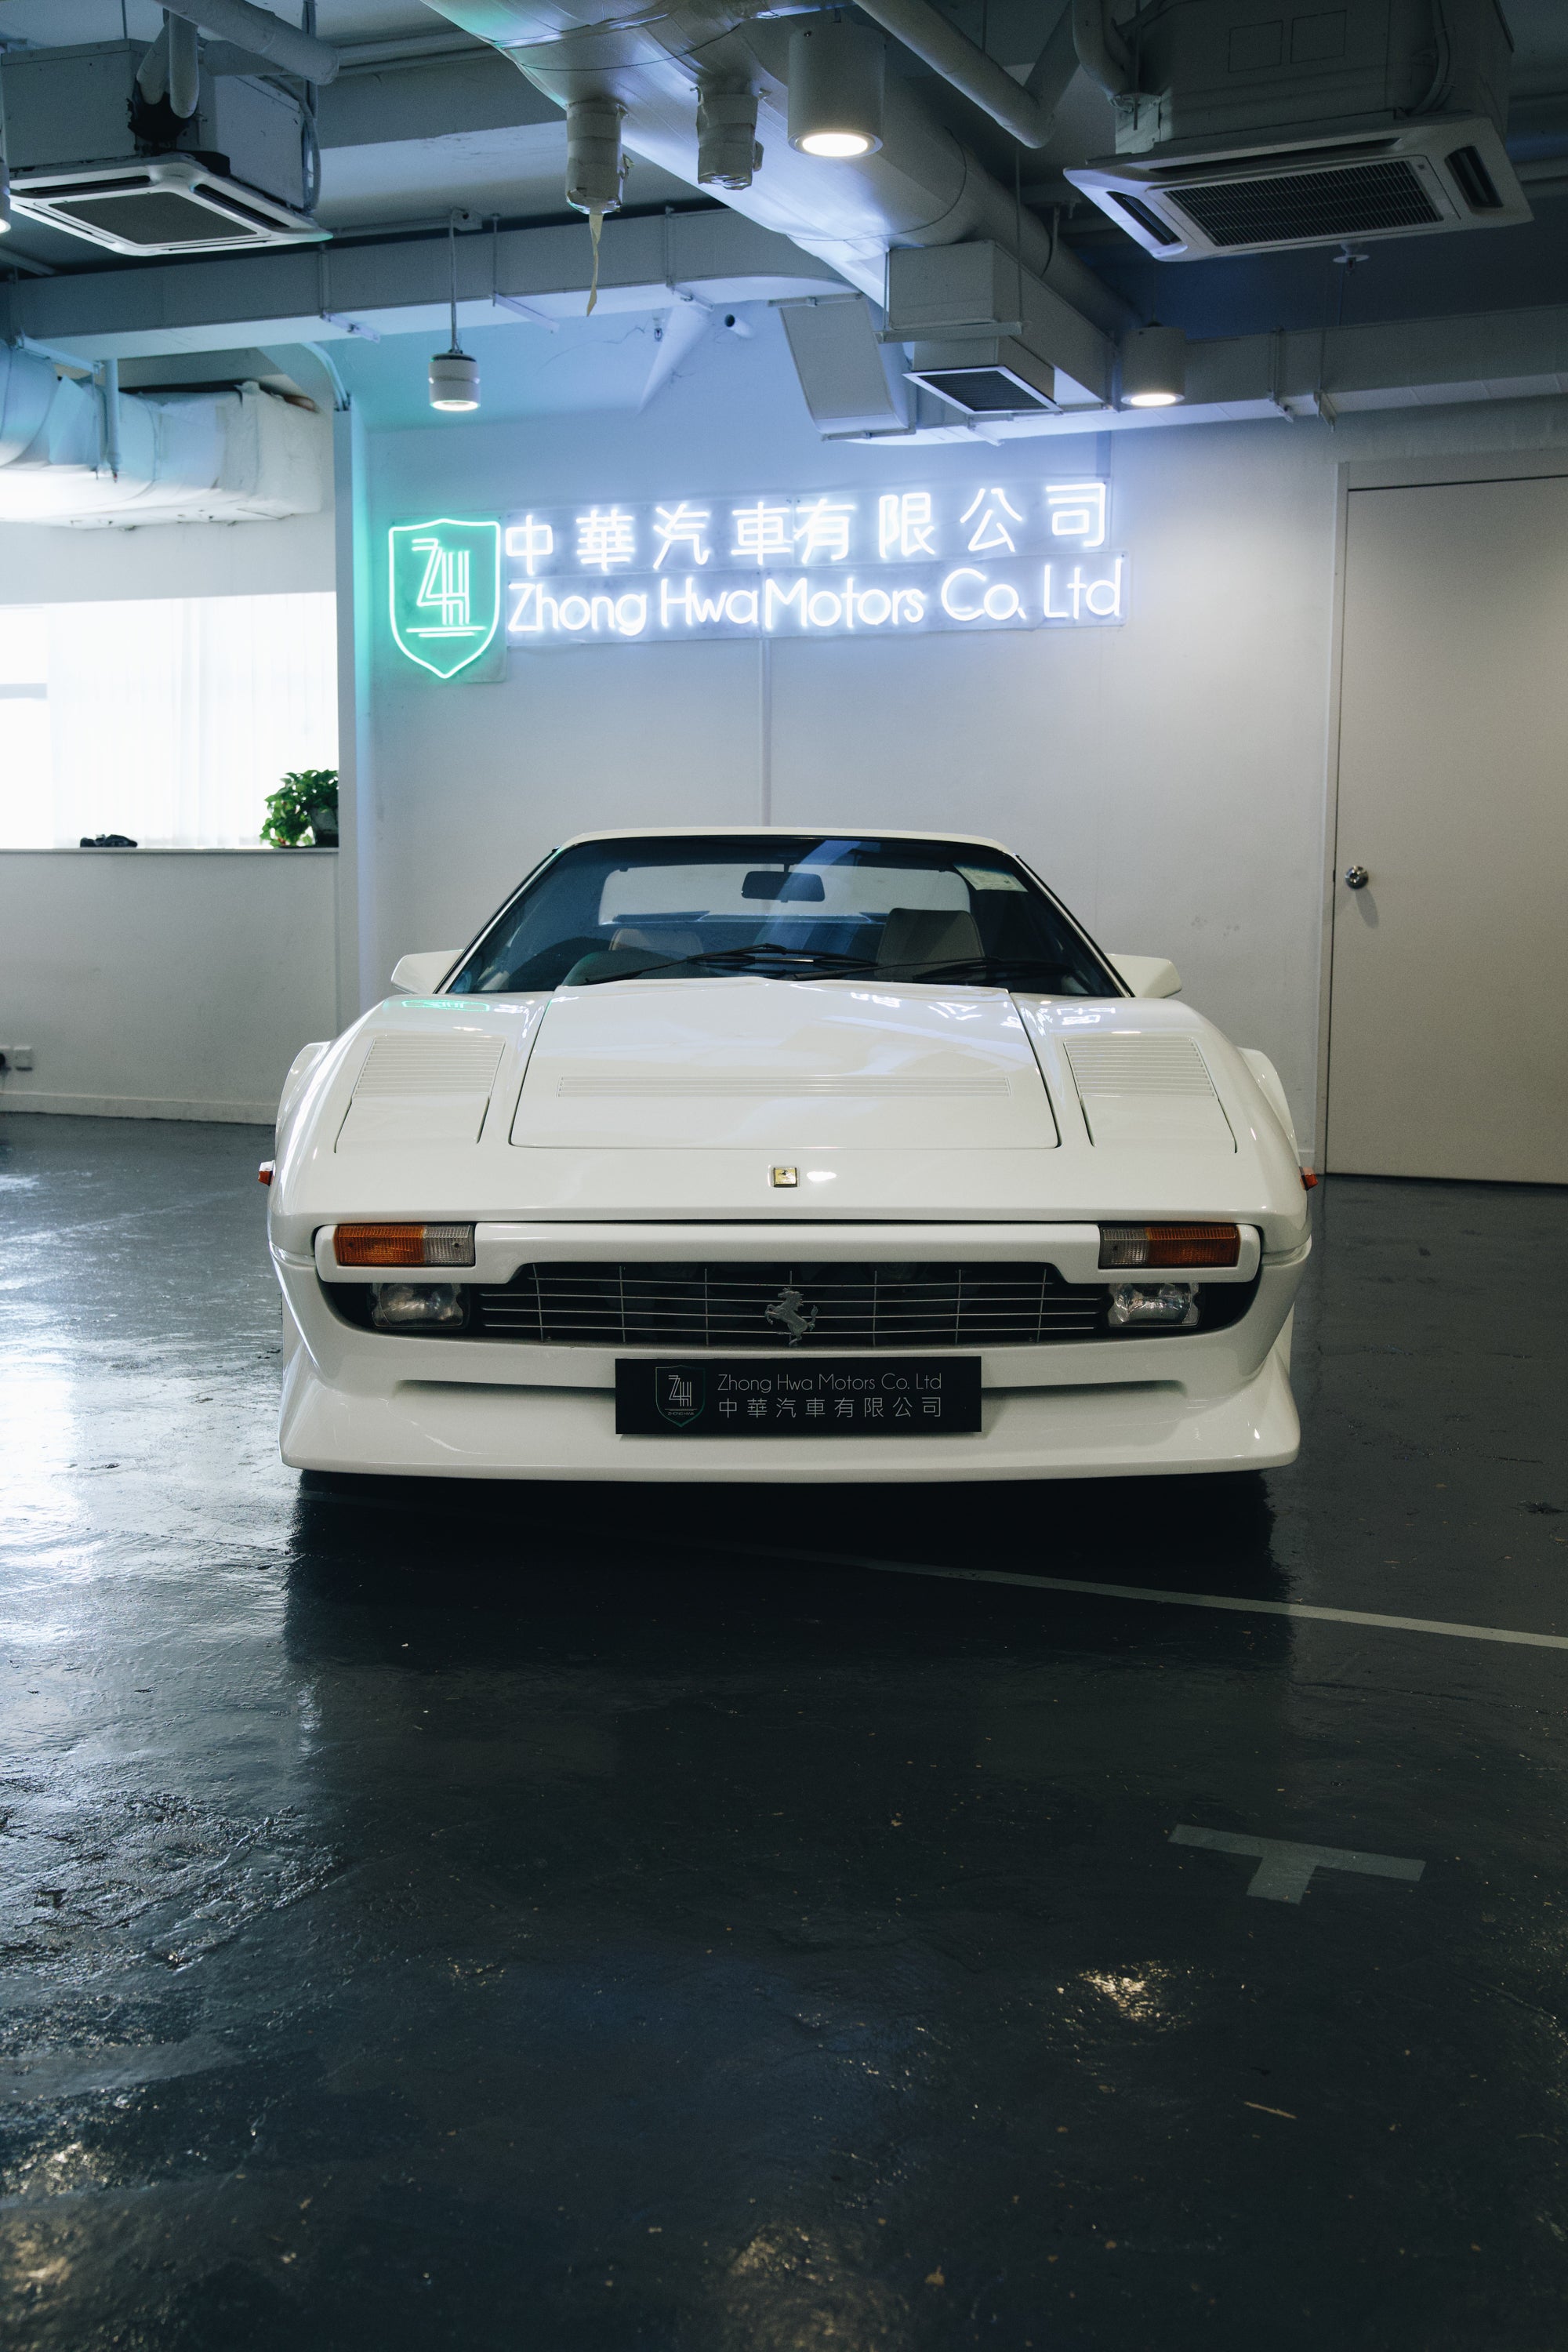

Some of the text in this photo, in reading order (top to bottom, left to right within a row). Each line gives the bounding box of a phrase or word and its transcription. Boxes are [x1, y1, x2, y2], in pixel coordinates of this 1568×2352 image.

[506, 482, 1105, 576] 中華汽車有限公司
[508, 583, 648, 637] Zhong
[660, 576, 760, 628] Hwa
[765, 576, 927, 631] Motors
[1043, 558, 1123, 620] Ltd
[717, 1373, 942, 1393] Zhong Hwa Motors Co. Ltd
[718, 1397, 941, 1418] 中華汽車有限公司
